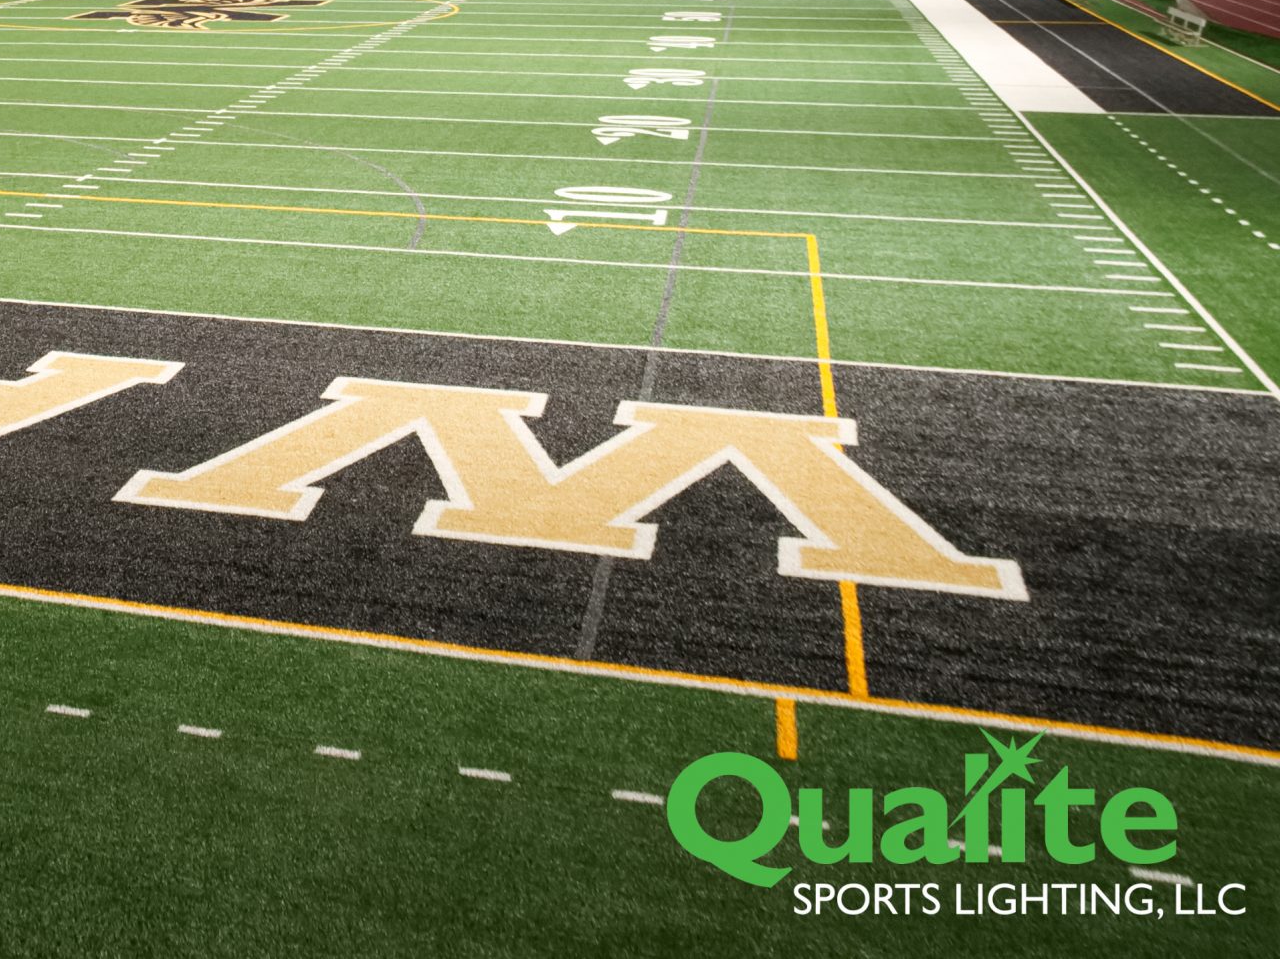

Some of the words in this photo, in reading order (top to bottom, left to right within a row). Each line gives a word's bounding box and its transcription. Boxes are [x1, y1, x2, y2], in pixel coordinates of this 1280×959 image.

[623, 68, 707, 87] 30
[591, 115, 692, 141] 20
[543, 186, 673, 226] 10
